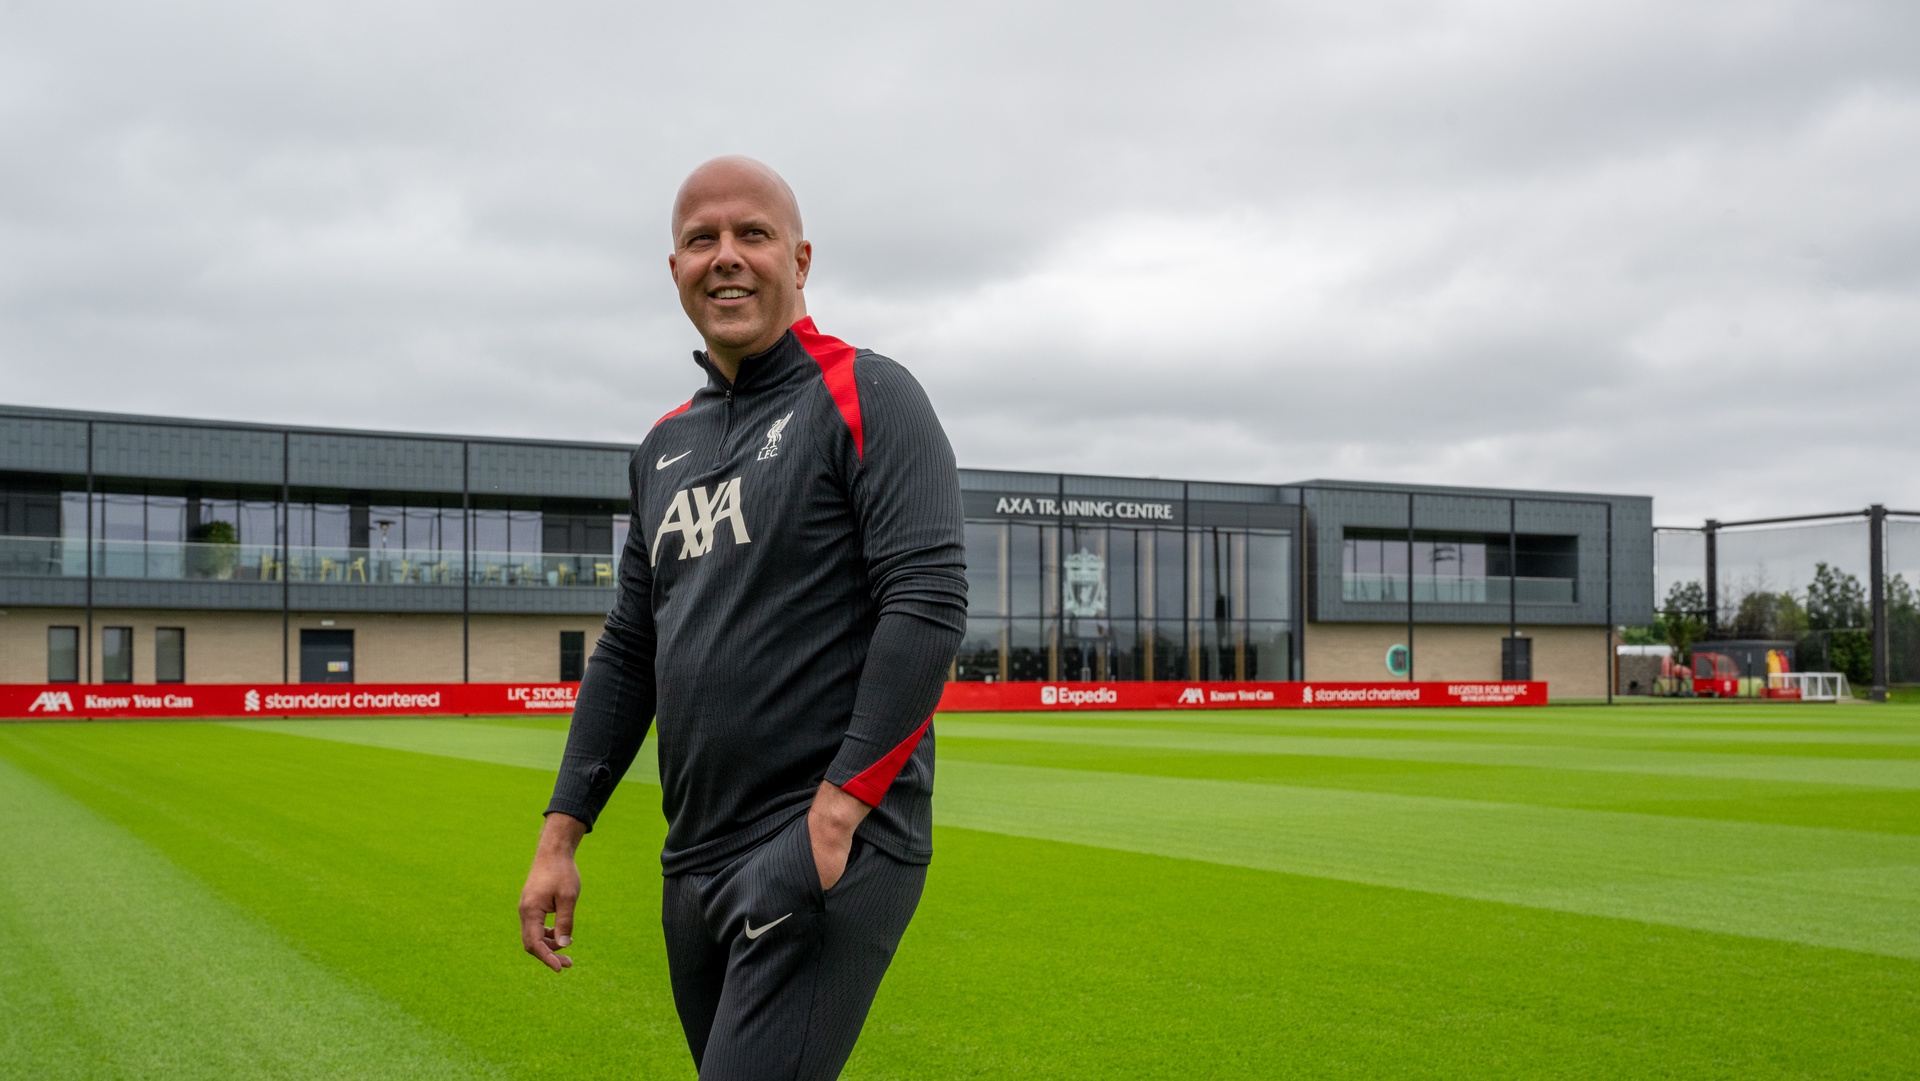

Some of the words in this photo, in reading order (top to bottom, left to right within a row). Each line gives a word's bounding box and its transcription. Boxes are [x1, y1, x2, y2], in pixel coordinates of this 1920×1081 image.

[996, 497, 1034, 515] AXA
[1115, 502, 1173, 520] CENTRE
[651, 476, 751, 567] AXA
[29, 692, 73, 711] AXA
[85, 695, 130, 708] Know
[133, 695, 162, 708] You
[164, 695, 193, 708] Can
[265, 693, 350, 708] standard
[353, 692, 440, 708] chartered
[508, 688, 530, 700] LFC
[533, 688, 573, 700] STORE
[1059, 687, 1117, 706] Expedia
[1210, 691, 1237, 701] Know
[1238, 690, 1256, 700] You
[1256, 690, 1274, 700] Can
[1315, 689, 1367, 701] standard
[1367, 689, 1419, 700] chartered
